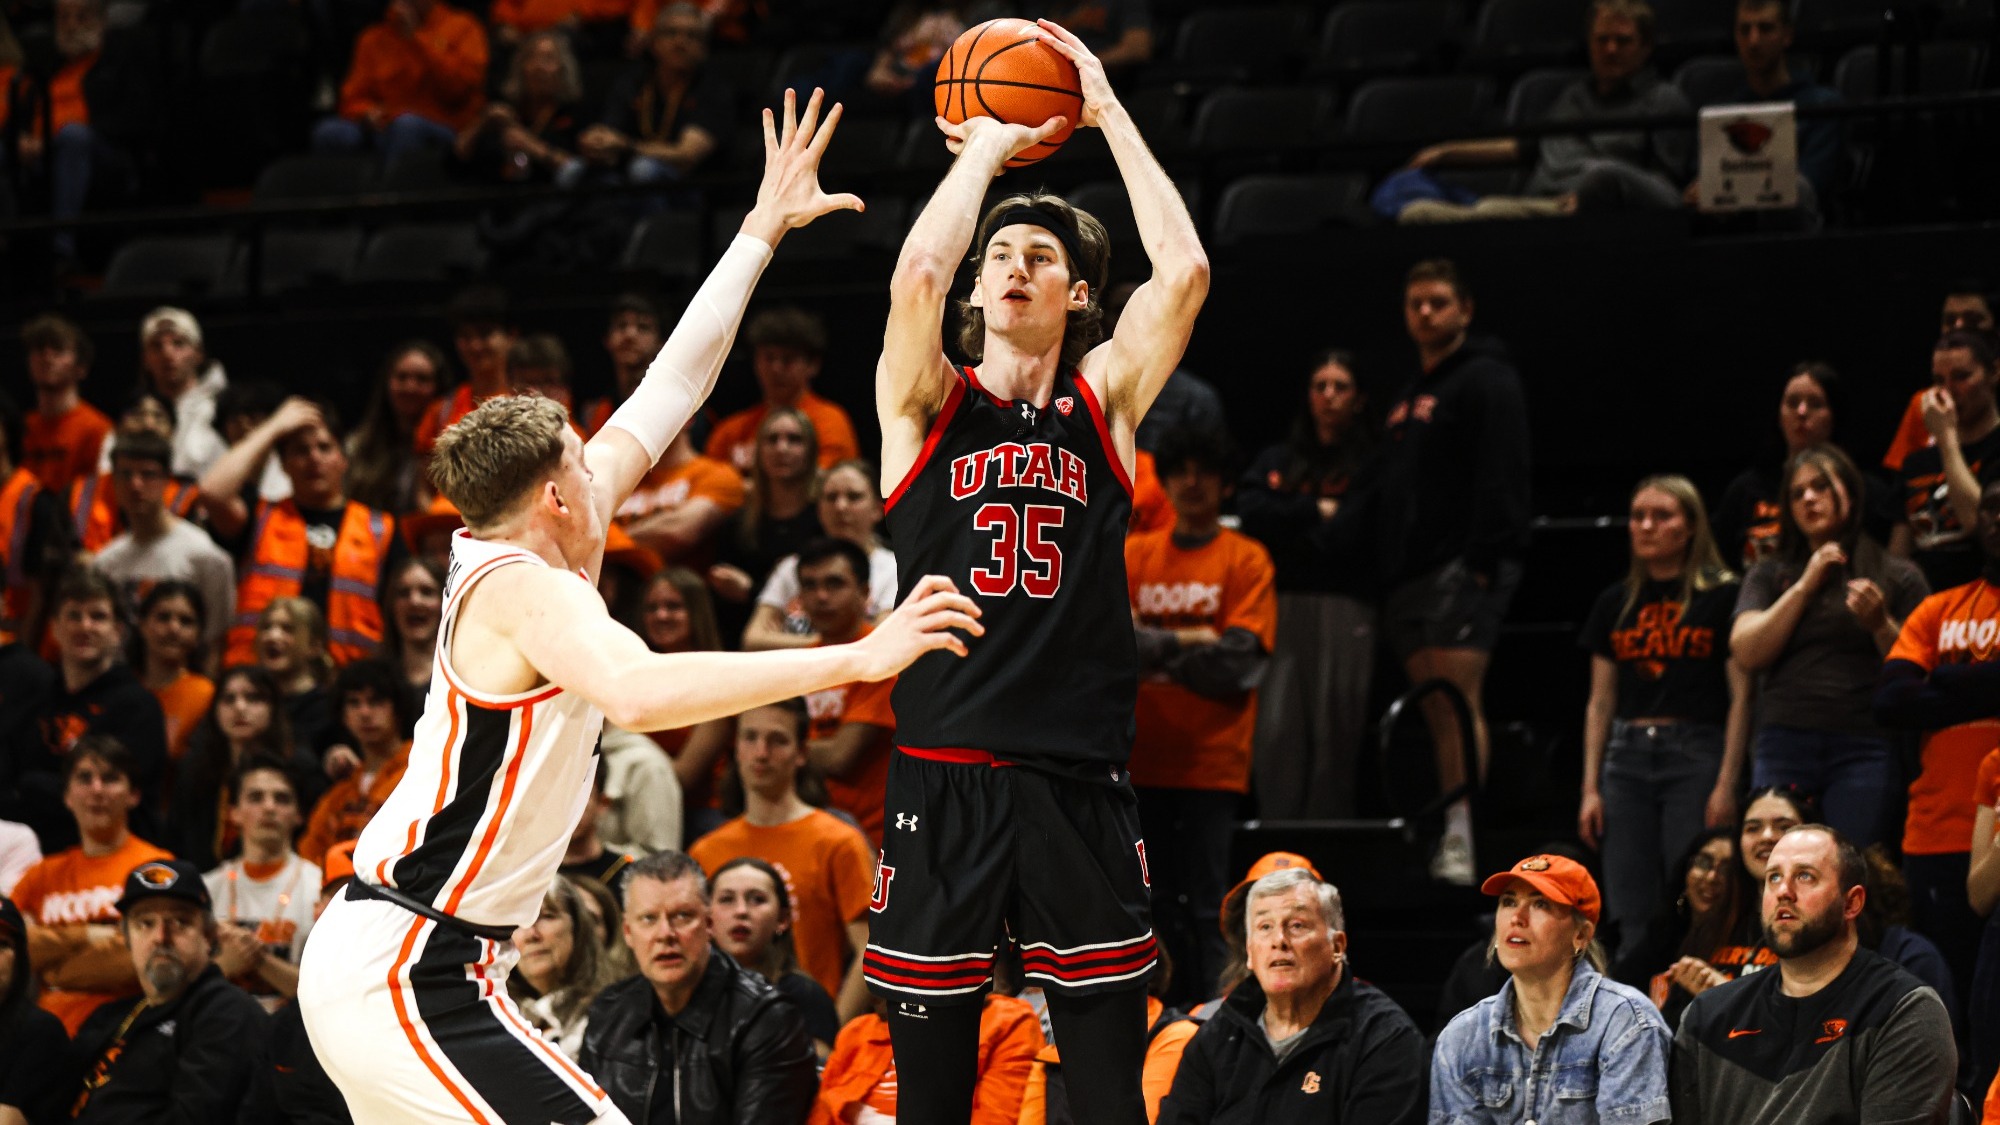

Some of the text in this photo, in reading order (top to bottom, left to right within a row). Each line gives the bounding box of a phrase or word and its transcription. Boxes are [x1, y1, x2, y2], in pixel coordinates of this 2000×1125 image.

[951, 442, 1088, 507] UTAH
[970, 503, 1065, 598] 35
[1609, 626, 1713, 660] BEAVS
[1938, 617, 2000, 653] HOO
